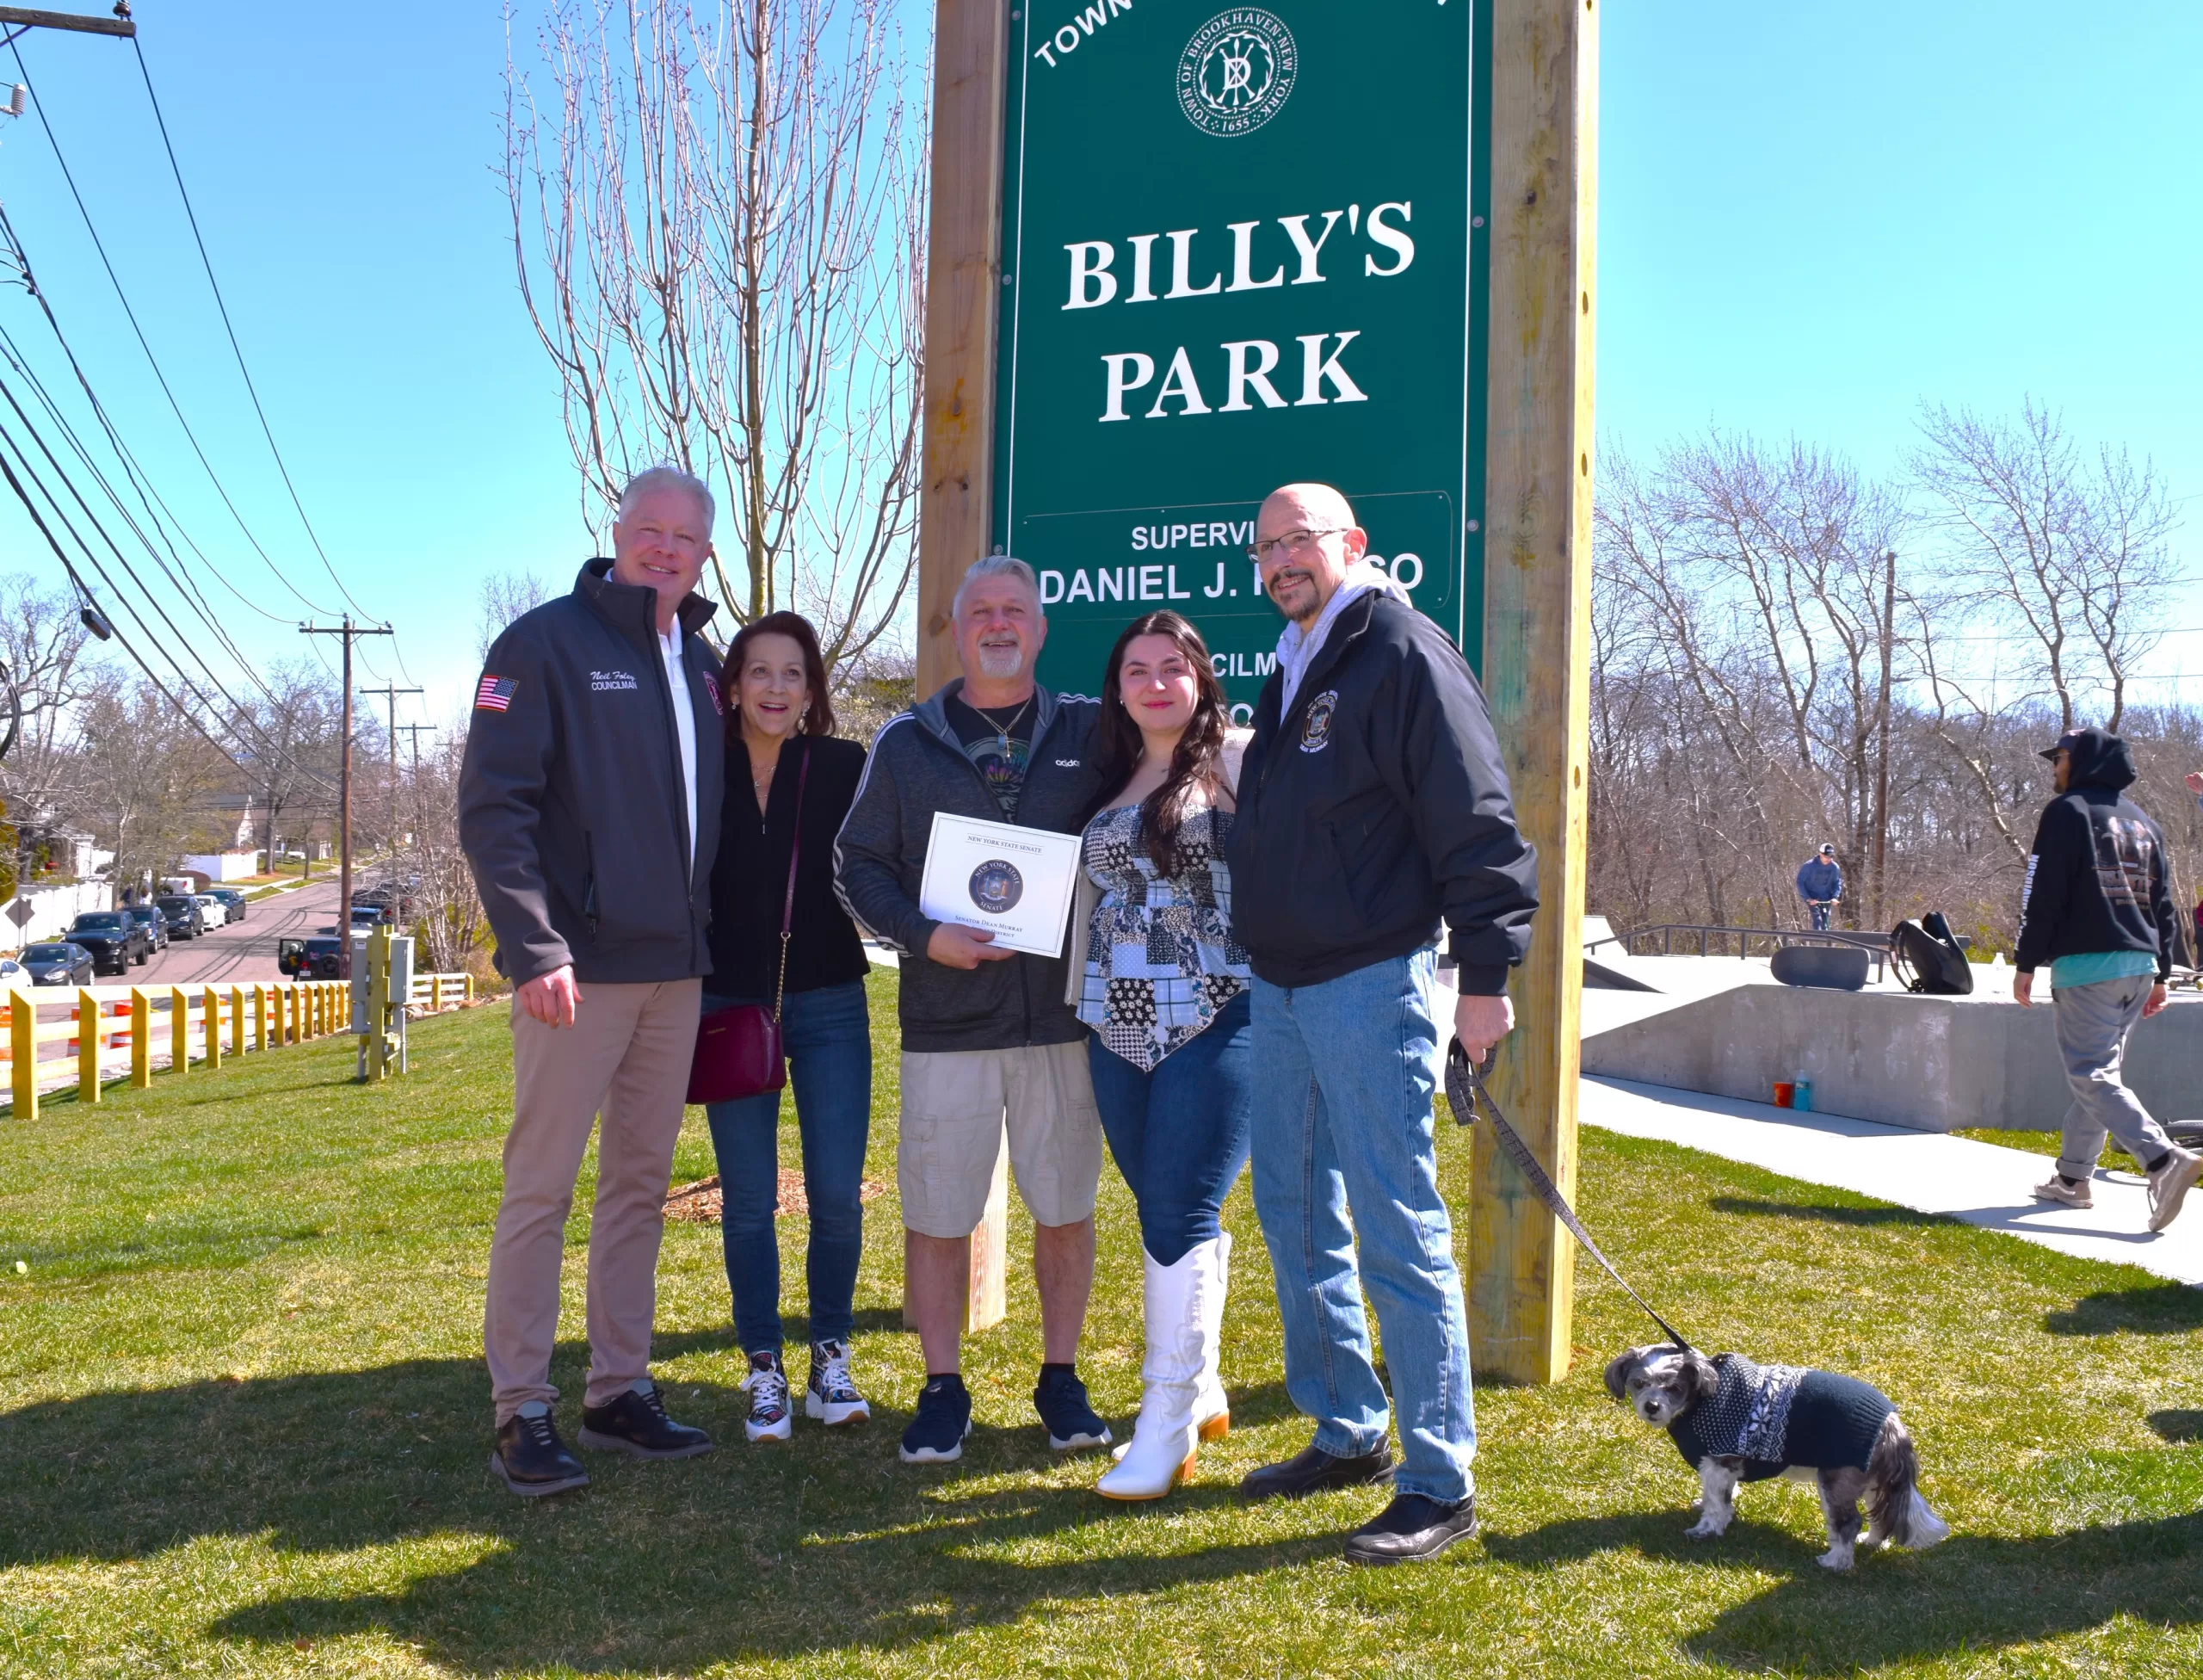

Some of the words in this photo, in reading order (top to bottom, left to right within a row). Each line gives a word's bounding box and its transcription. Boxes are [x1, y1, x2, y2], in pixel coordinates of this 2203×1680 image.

[1034, 0, 1132, 68] TOWN
[1188, 12, 1280, 58] BROOKHAVEN
[1278, 36, 1293, 71] NEW
[1181, 62, 1193, 83] OF
[1182, 87, 1210, 127] TOWN
[1260, 78, 1291, 118] YORK
[1223, 118, 1250, 132] 1655
[1061, 201, 1415, 312] BILLY'S
[1098, 330, 1368, 423] PARK
[1131, 521, 1255, 551] SUPERVI
[1040, 565, 1191, 604] DANIEL
[1204, 562, 1237, 599] J.
[589, 670, 612, 680] Neil
[612, 670, 636, 682] Foley
[591, 681, 638, 691] COUNCILMAN
[983, 838, 1001, 847] YORK
[1000, 842, 1019, 850] STATE
[1019, 845, 1042, 854] SENATE
[974, 864, 988, 878] NEW
[989, 862, 1008, 870] YORK
[1007, 865, 1021, 886] STATE
[979, 901, 1003, 911] SENATE
[954, 915, 981, 925] SENATOR
[981, 919, 998, 928] DEAN
[998, 923, 1023, 932] MURRAY
